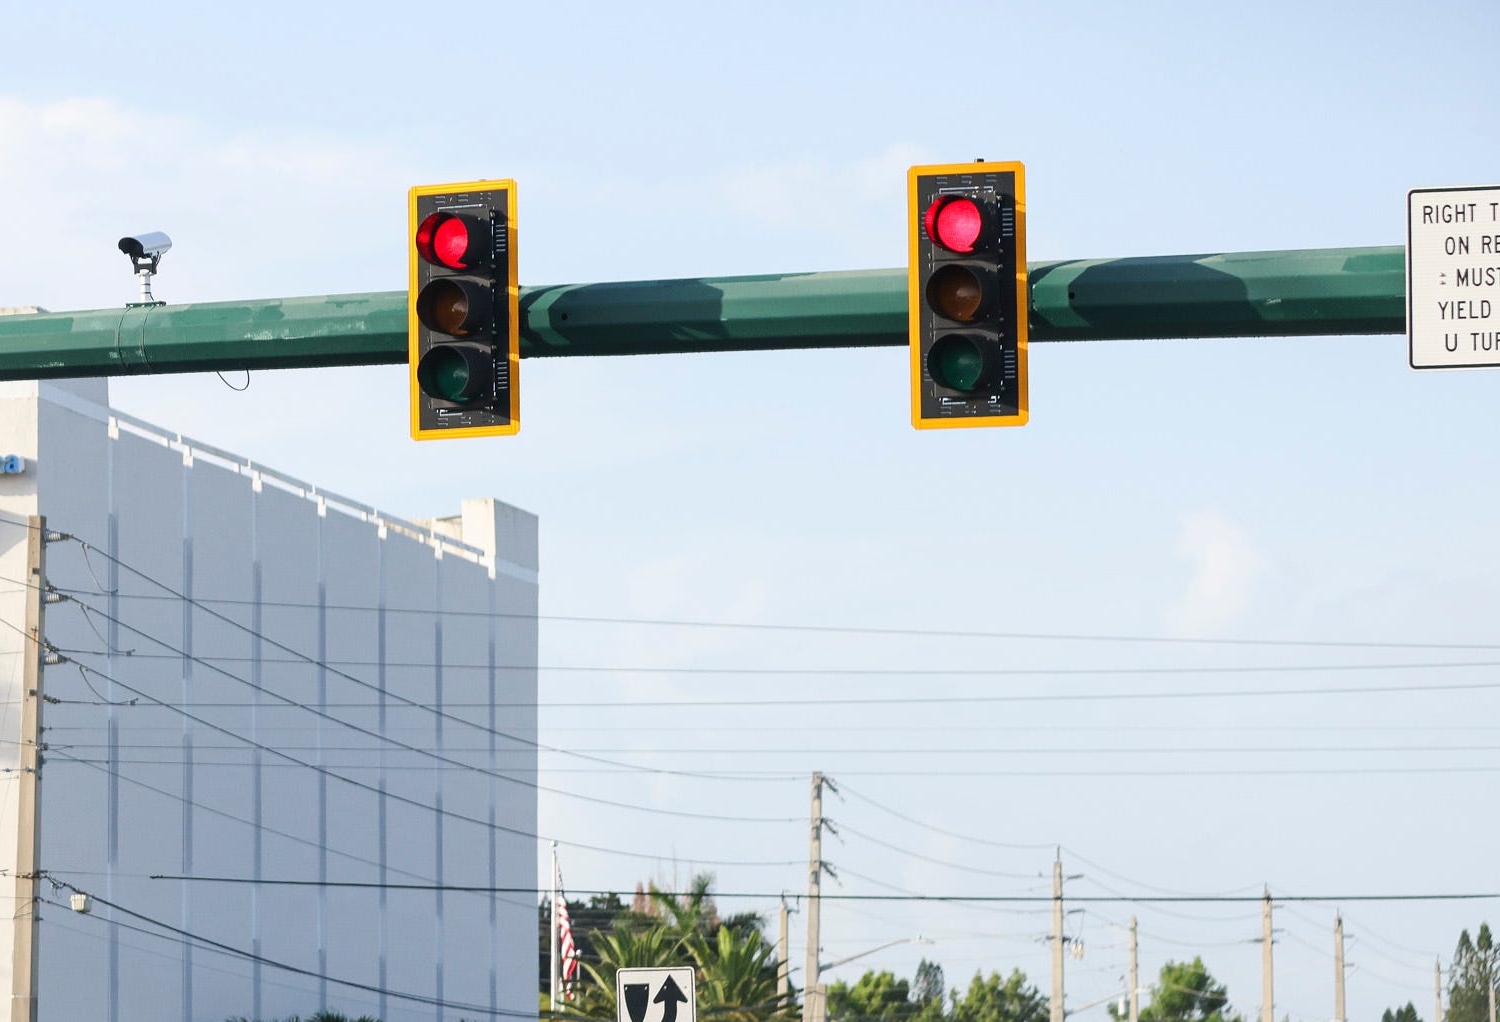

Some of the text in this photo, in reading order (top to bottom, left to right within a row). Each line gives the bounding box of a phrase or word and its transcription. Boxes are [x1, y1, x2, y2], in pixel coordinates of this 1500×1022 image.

[1422, 204, 1477, 224] RIGHT
[1445, 235, 1470, 256] ON
[1437, 299, 1492, 320] YIELD
[1445, 333, 1458, 352] U
